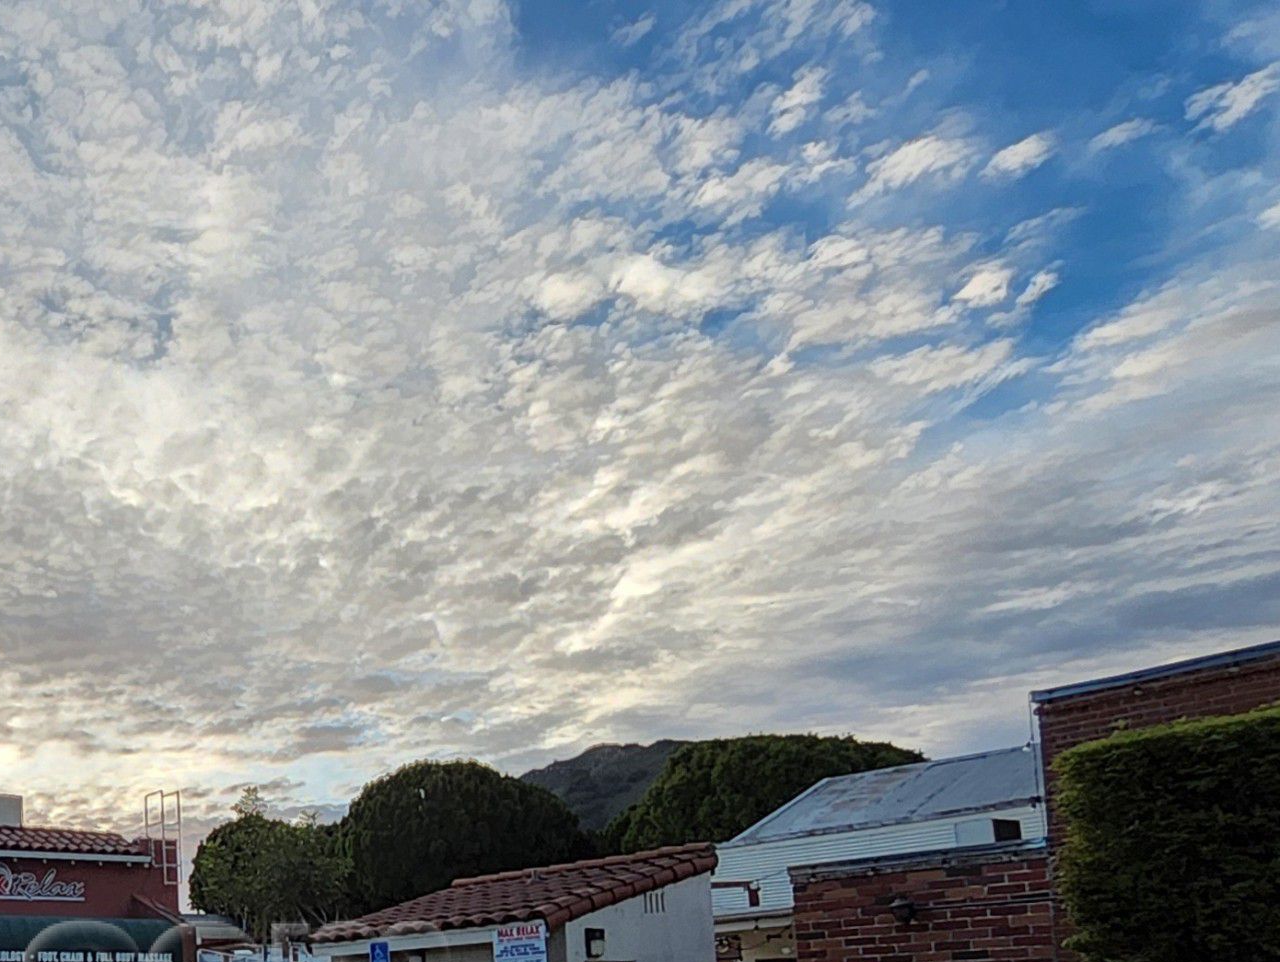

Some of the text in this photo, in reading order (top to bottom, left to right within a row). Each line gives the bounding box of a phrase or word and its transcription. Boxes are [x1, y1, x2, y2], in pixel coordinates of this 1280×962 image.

[11, 867, 86, 901] Relax
[37, 950, 59, 962] FOOT,
[60, 951, 85, 962] CHAIR
[86, 951, 93, 962] &
[96, 951, 114, 962] FULL
[115, 951, 136, 962] BODY
